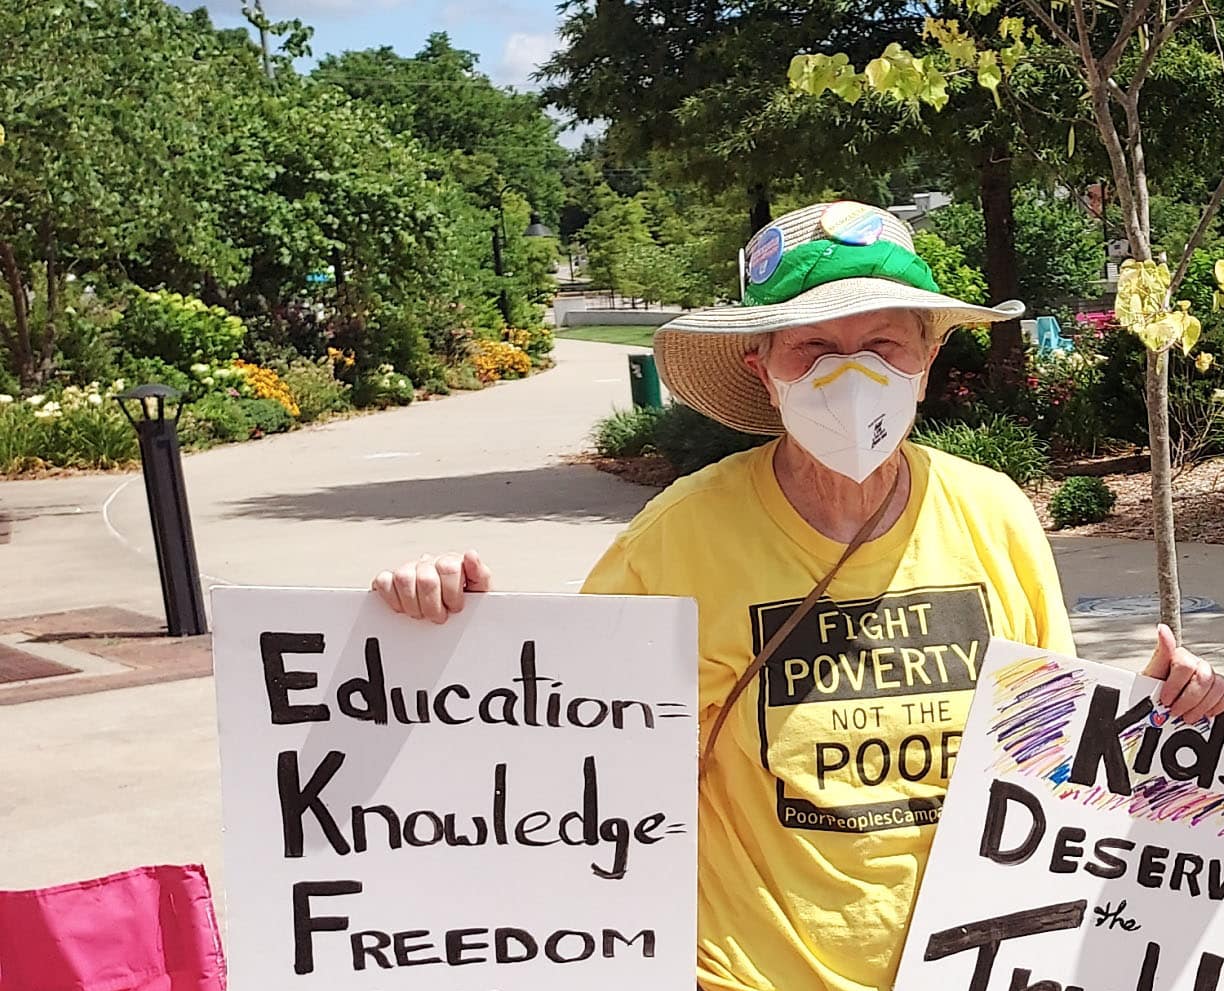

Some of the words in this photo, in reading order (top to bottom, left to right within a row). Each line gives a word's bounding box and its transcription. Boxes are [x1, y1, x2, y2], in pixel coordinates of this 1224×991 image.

[818, 603, 932, 643] FIGHT
[783, 640, 980, 696] POVERTY
[832, 706, 884, 730] NOT
[902, 700, 951, 725] THE
[292, 880, 656, 975] FREEDOM
[1093, 900, 1142, 932] the
